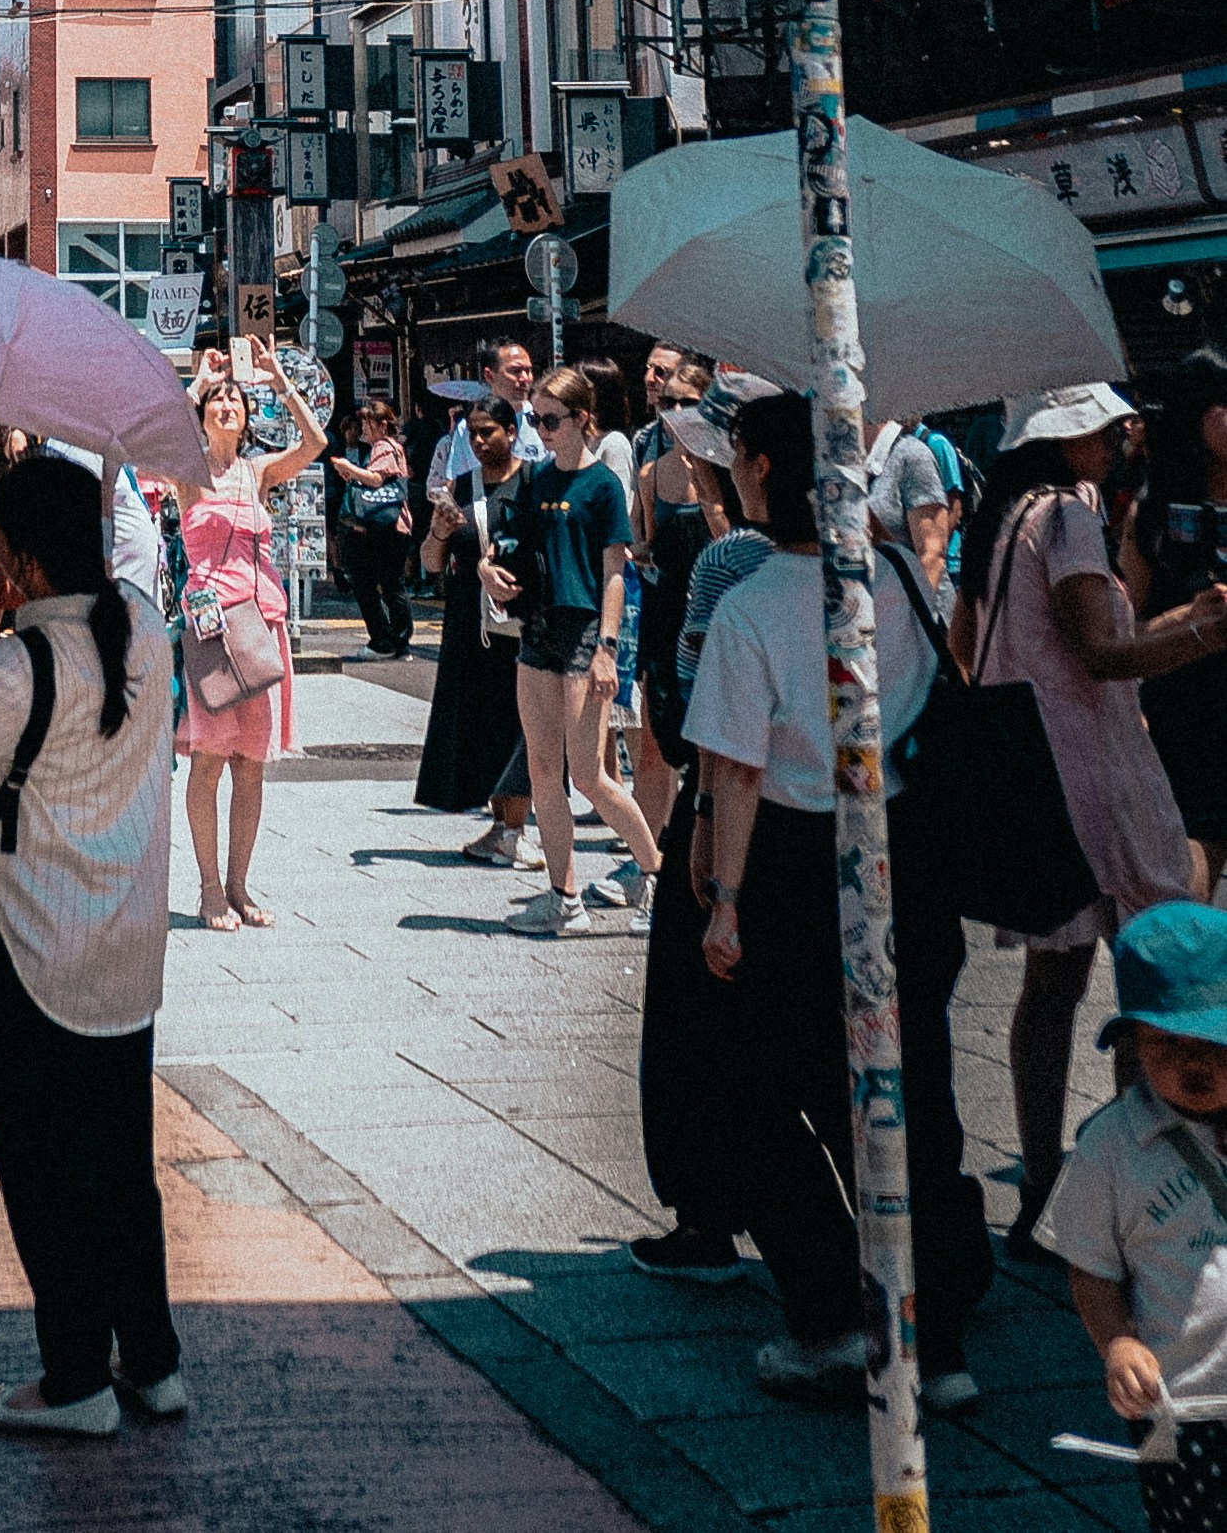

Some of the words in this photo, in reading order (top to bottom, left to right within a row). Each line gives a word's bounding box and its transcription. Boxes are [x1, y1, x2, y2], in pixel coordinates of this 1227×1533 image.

[300, 49, 315, 104] にしだ
[150, 286, 201, 300] RAMEN
